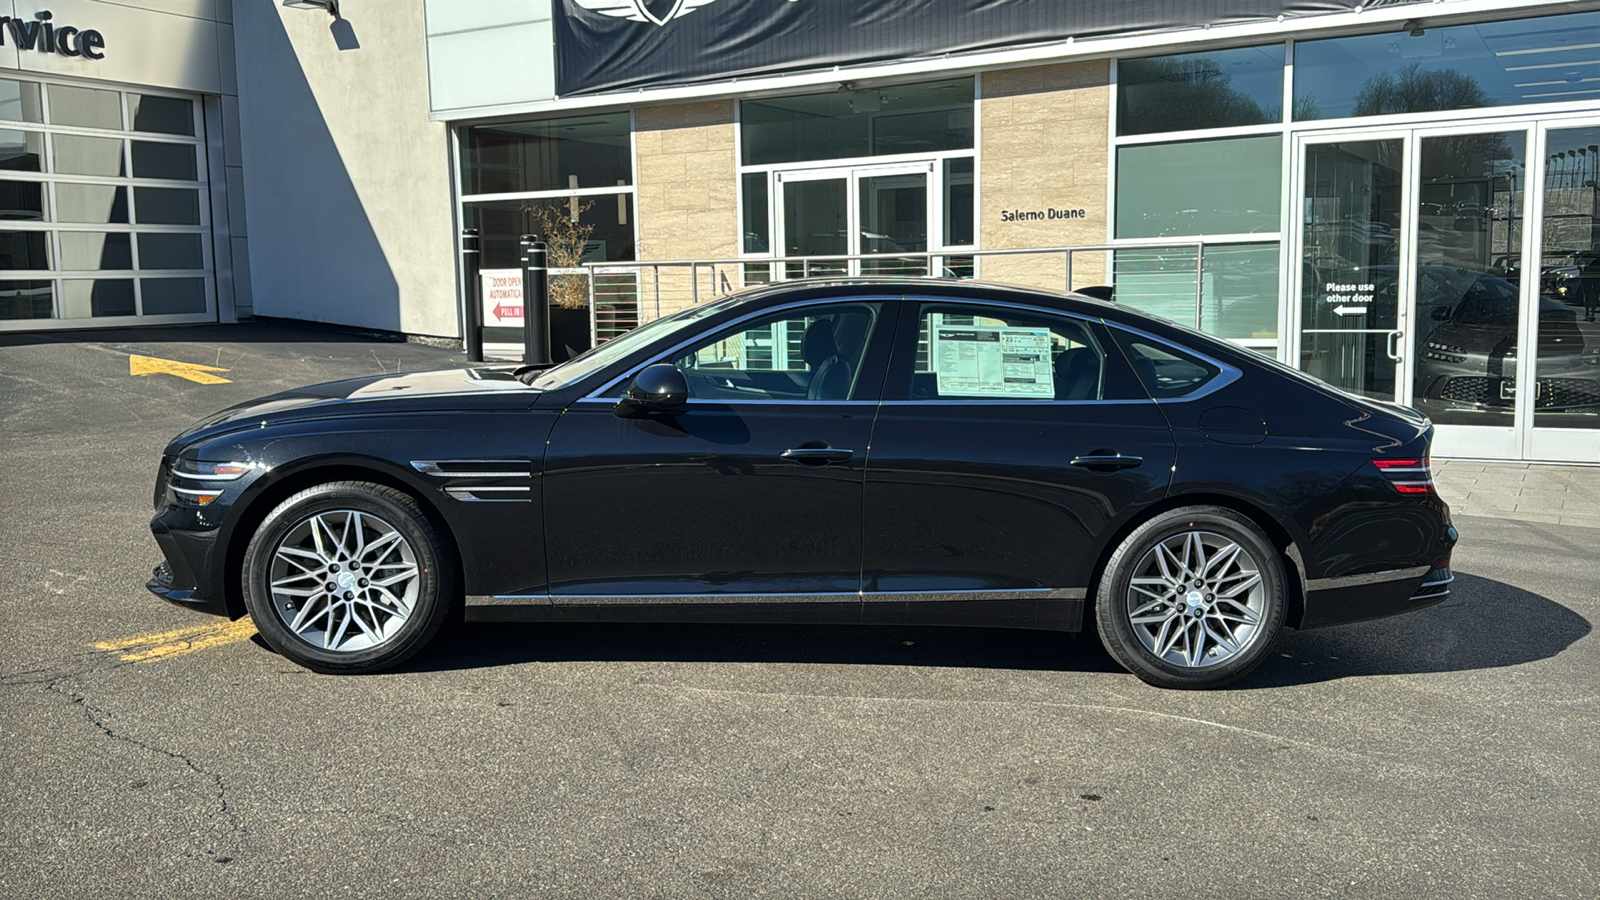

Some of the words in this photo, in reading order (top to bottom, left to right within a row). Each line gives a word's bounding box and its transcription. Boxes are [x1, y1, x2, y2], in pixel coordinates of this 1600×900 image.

[1001, 209, 1045, 221] Salerno
[1047, 208, 1085, 219] Duane
[493, 278, 507, 287] DOOR
[1326, 283, 1356, 291] Please
[1326, 294, 1351, 302] other
[1352, 293, 1374, 302] door
